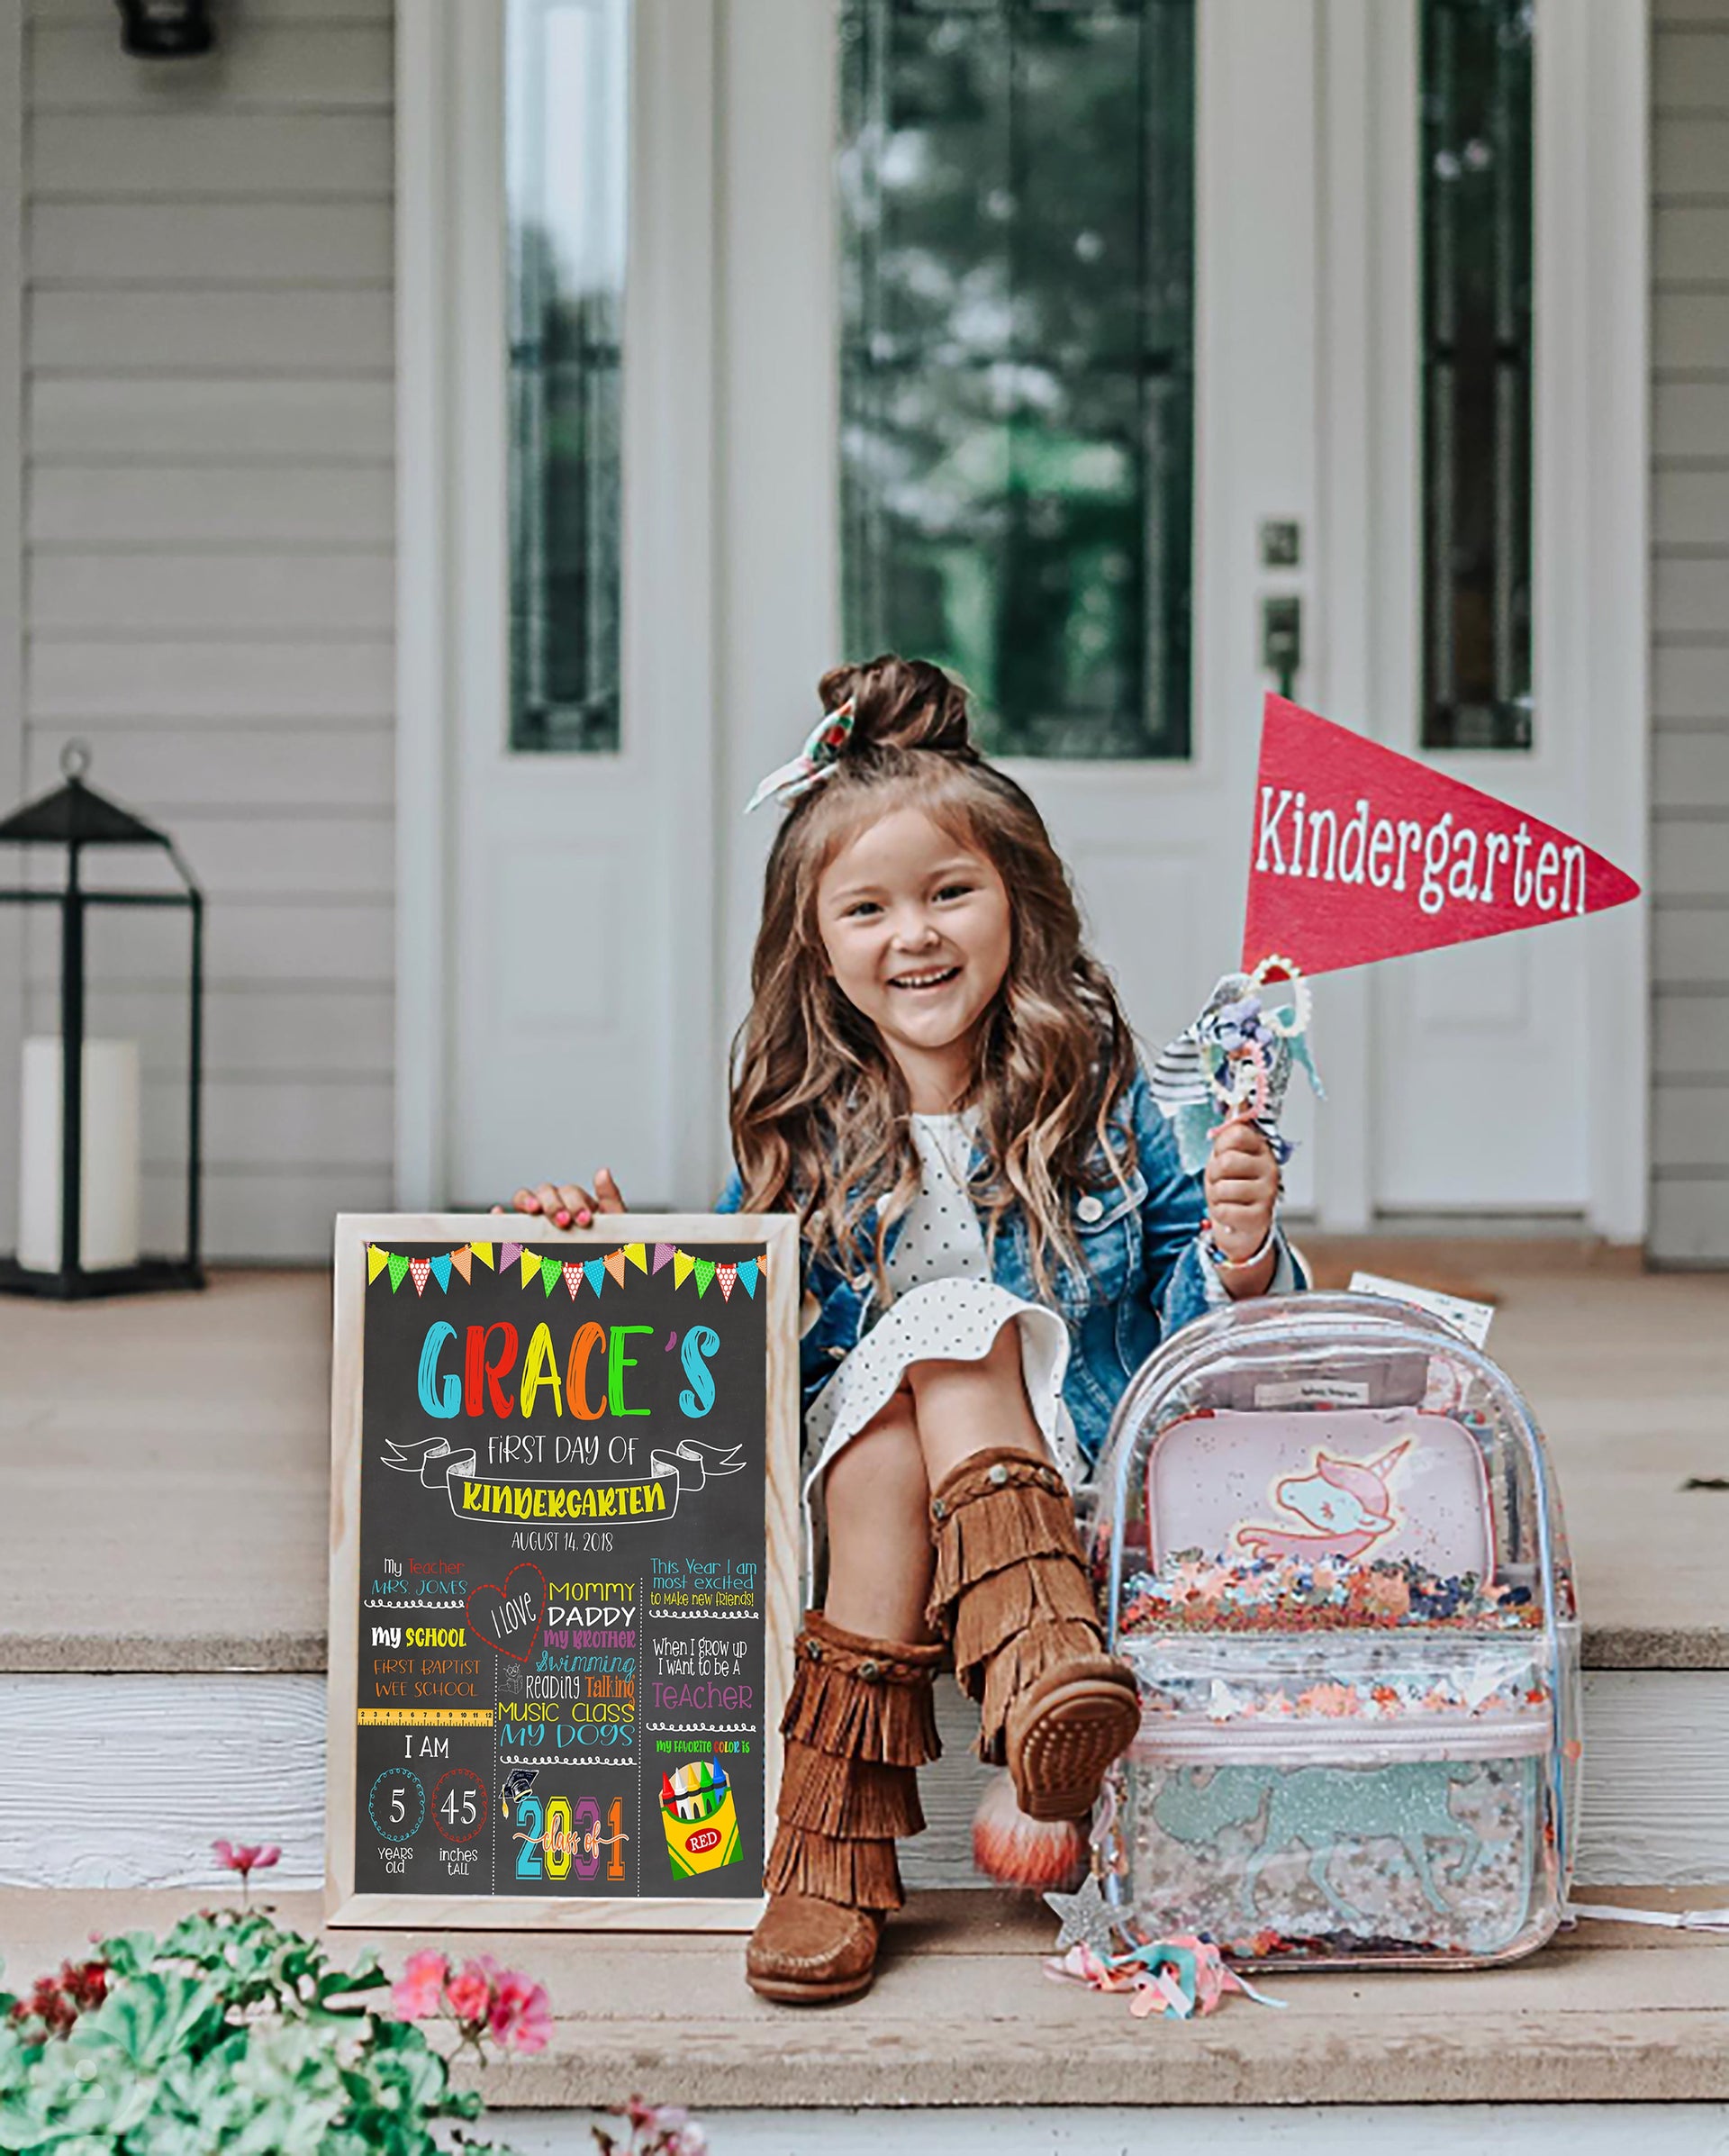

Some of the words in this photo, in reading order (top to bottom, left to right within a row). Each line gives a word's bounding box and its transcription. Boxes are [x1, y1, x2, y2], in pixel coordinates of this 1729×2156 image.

[1254, 786, 1587, 916] Kindergarten
[418, 1321, 720, 1420] GRACE'S
[556, 1436, 599, 1465] DAY
[609, 1436, 638, 1465] OF
[461, 1481, 667, 1520] KINDERGARTEN
[511, 1532, 558, 1551] AUGUST
[584, 1533, 612, 1552] 2018
[408, 1557, 465, 1575] Teacher
[651, 1558, 679, 1574] This
[686, 1558, 720, 1574] Year
[736, 1563, 756, 1574] am
[416, 1580, 468, 1595] JONES
[654, 1576, 687, 1589] most
[693, 1575, 755, 1591] excited
[548, 1607, 636, 1626] DADDY
[406, 1628, 466, 1647] SCHOOL
[653, 1637, 687, 1656] When
[535, 1649, 637, 1683] Swimming
[376, 1681, 407, 1697] WEE
[414, 1681, 478, 1698] SCHOOL
[405, 1735, 412, 1758] I
[419, 1736, 448, 1758] AM
[713, 1741, 739, 1753] COLOR
[389, 1788, 404, 1823] 5
[440, 1789, 476, 1825] 45
[512, 1813, 580, 1853] class
[515, 1796, 626, 1881] 2031
[690, 1830, 719, 1851] RED
